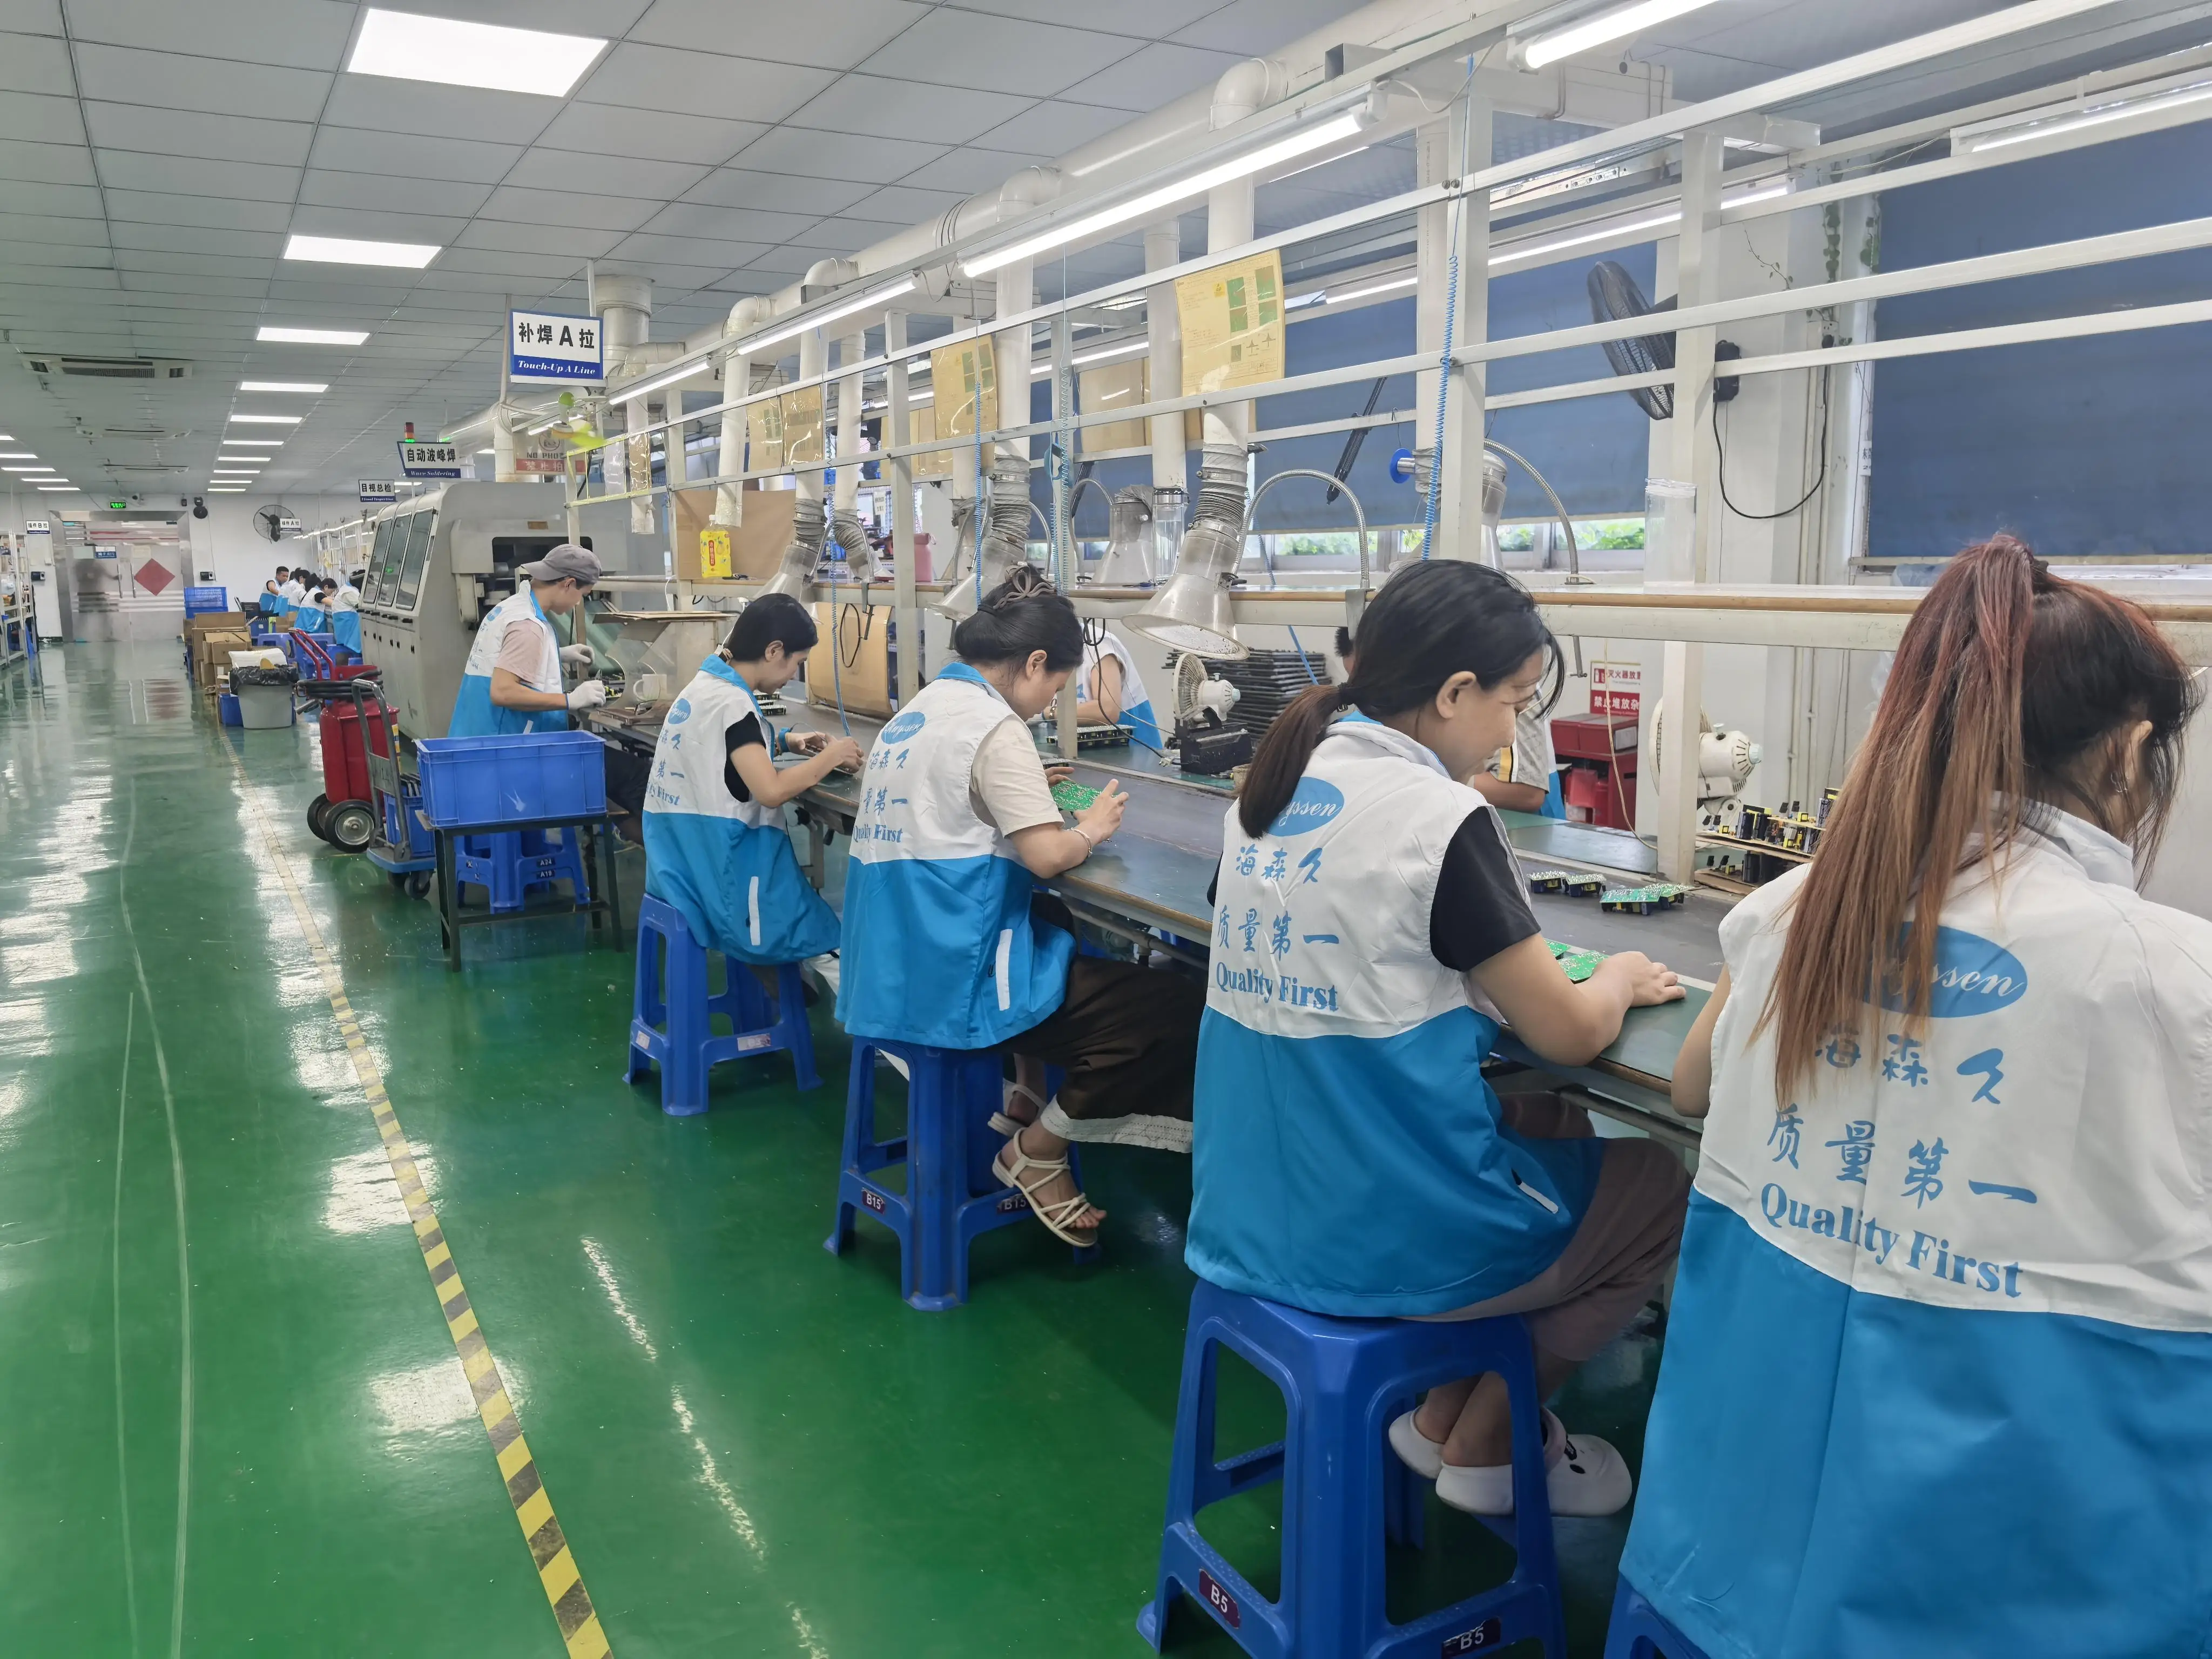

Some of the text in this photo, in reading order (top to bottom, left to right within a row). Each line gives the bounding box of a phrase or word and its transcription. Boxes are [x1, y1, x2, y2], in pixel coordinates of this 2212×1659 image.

[518, 322, 595, 349] 补焊A拉
[518, 360, 563, 373] Touch-Up
[574, 366, 595, 375] Line
[407, 448, 456, 462] 自动波峰焊
[526, 461, 564, 472] 禁止拍
[361, 483, 392, 493] 目视总检
[657, 785, 680, 806] First
[860, 786, 908, 817] 量第一
[1279, 799, 1341, 826] yssen
[873, 824, 903, 843] First
[1236, 843, 1323, 884] 海森久
[1217, 904, 1340, 961] 质量第一
[1216, 962, 1339, 1013] Quality First
[1767, 1102, 2038, 1210] 质量第一
[866, 1194, 882, 1210] B15
[1004, 1197, 1026, 1210] B15
[1761, 1182, 2024, 1299] Quality First
[1210, 1584, 1229, 1614] B5
[1460, 1627, 1485, 1650] B5
